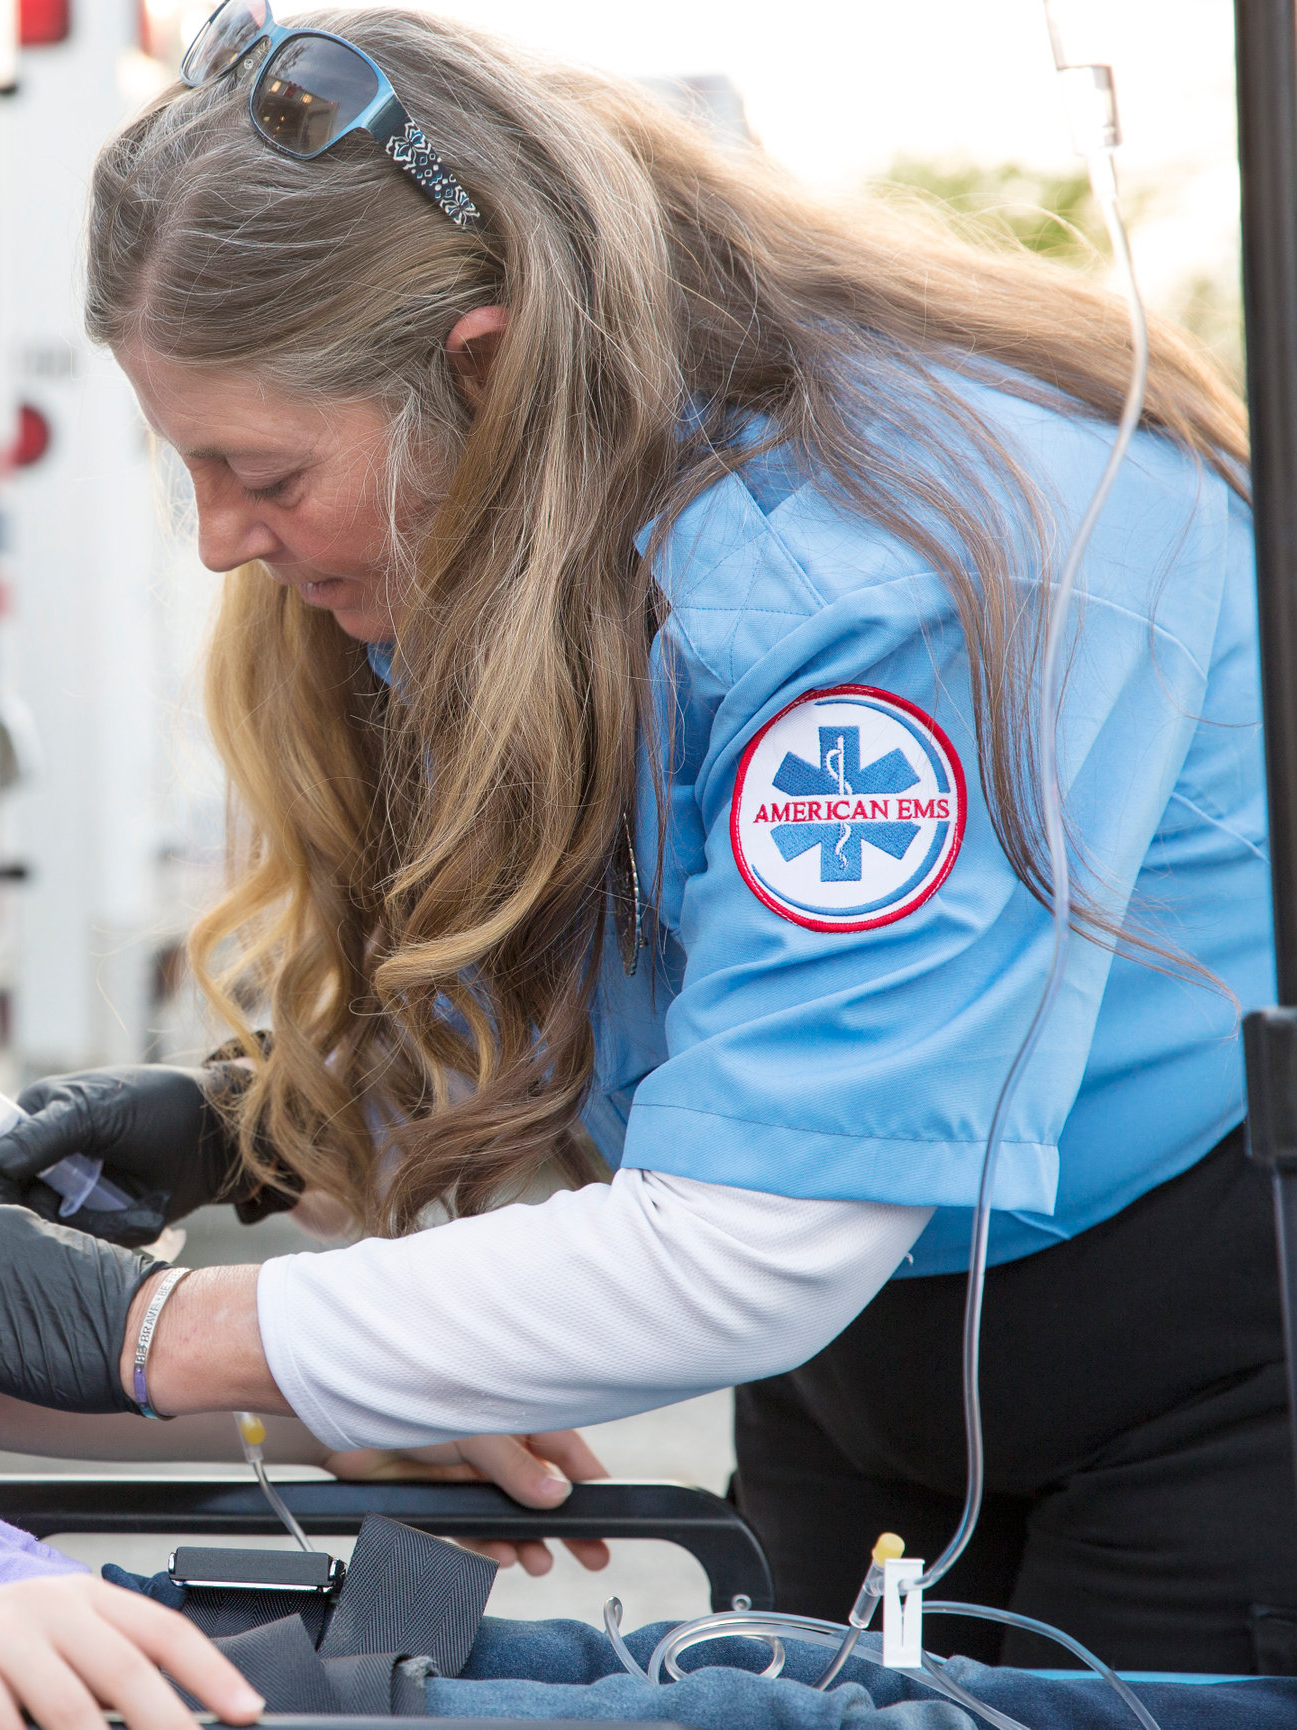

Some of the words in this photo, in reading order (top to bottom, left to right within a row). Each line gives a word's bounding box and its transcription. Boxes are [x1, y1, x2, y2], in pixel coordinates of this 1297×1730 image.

[753, 799, 890, 823] AMERICAN
[896, 798, 950, 820] EMS
[140, 1303, 160, 1342] BRAVE
